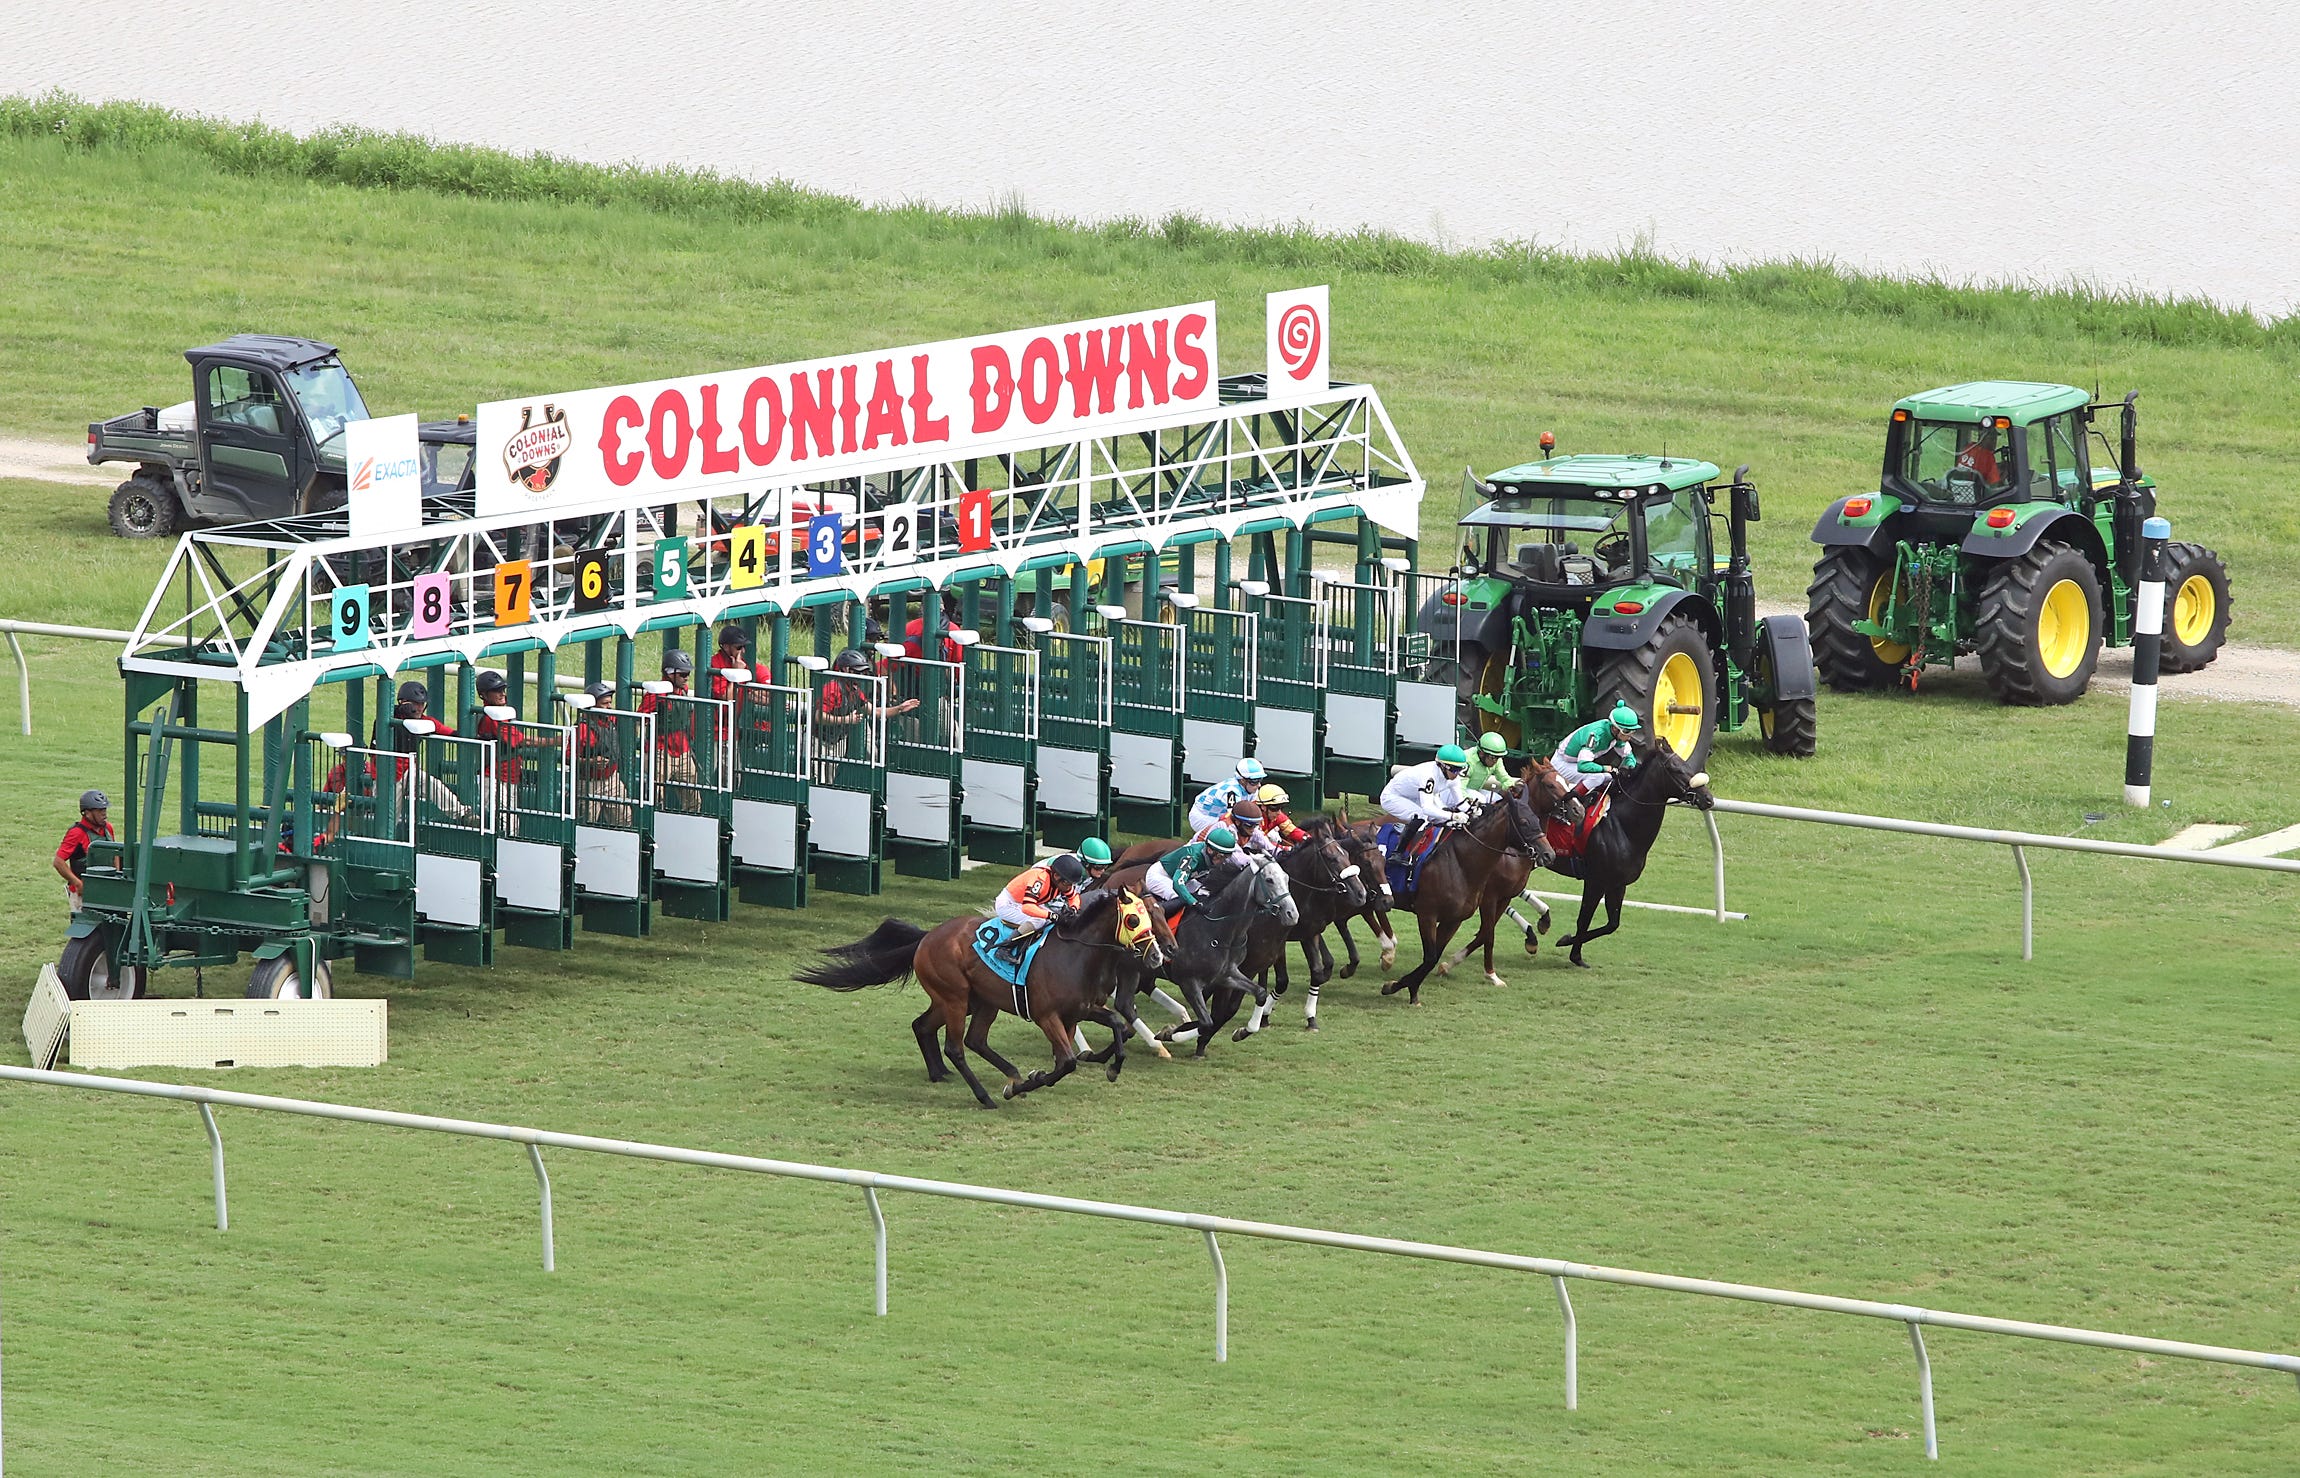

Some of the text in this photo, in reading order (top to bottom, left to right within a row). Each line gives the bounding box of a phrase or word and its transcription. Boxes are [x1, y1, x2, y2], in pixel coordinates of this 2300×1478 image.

[597, 313, 1209, 487] COLONIAL DOWNS
[509, 425, 566, 459] COLONIAL
[521, 443, 557, 463] DOWNS
[375, 459, 417, 481] EXACTA
[892, 516, 909, 552] 2
[969, 502, 982, 538] 1
[739, 539, 757, 574] 4
[815, 526, 835, 563] 3
[581, 561, 602, 599] 6
[660, 549, 681, 587] 5
[423, 586, 442, 623] 8
[504, 574, 522, 611] 7
[340, 598, 361, 636] 9
[1228, 794, 1236, 807] 4
[1425, 781, 1433, 793] 3
